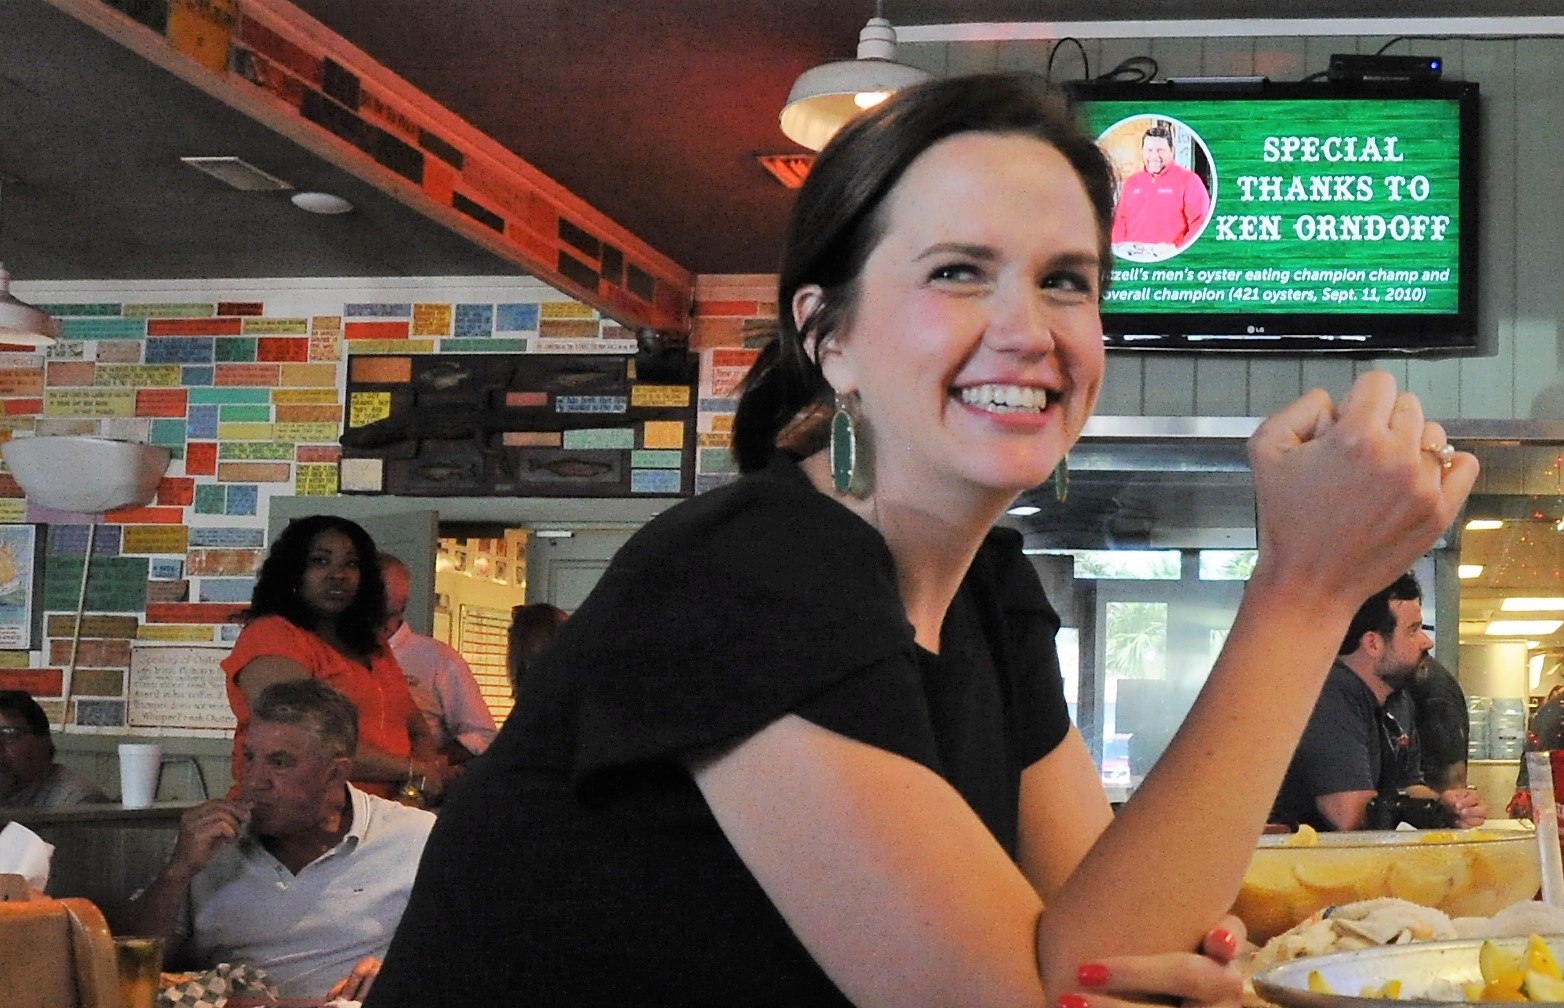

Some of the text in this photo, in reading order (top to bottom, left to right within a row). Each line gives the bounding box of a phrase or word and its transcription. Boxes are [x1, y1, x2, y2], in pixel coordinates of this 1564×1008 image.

[1263, 136, 1404, 163] SPECIAL
[1237, 176, 1430, 202] THANKS TO
[1215, 215, 1450, 242] KEN ORNDOFF
[1152, 268, 1194, 281] men's
[1197, 268, 1242, 283] oyster
[1244, 267, 1290, 284] eating
[1293, 268, 1365, 283] champion
[1369, 268, 1418, 283] champ
[1421, 268, 1450, 281] and
[1102, 286, 1427, 304] overall champion (421 oysters, Sept. 11, 2010)
